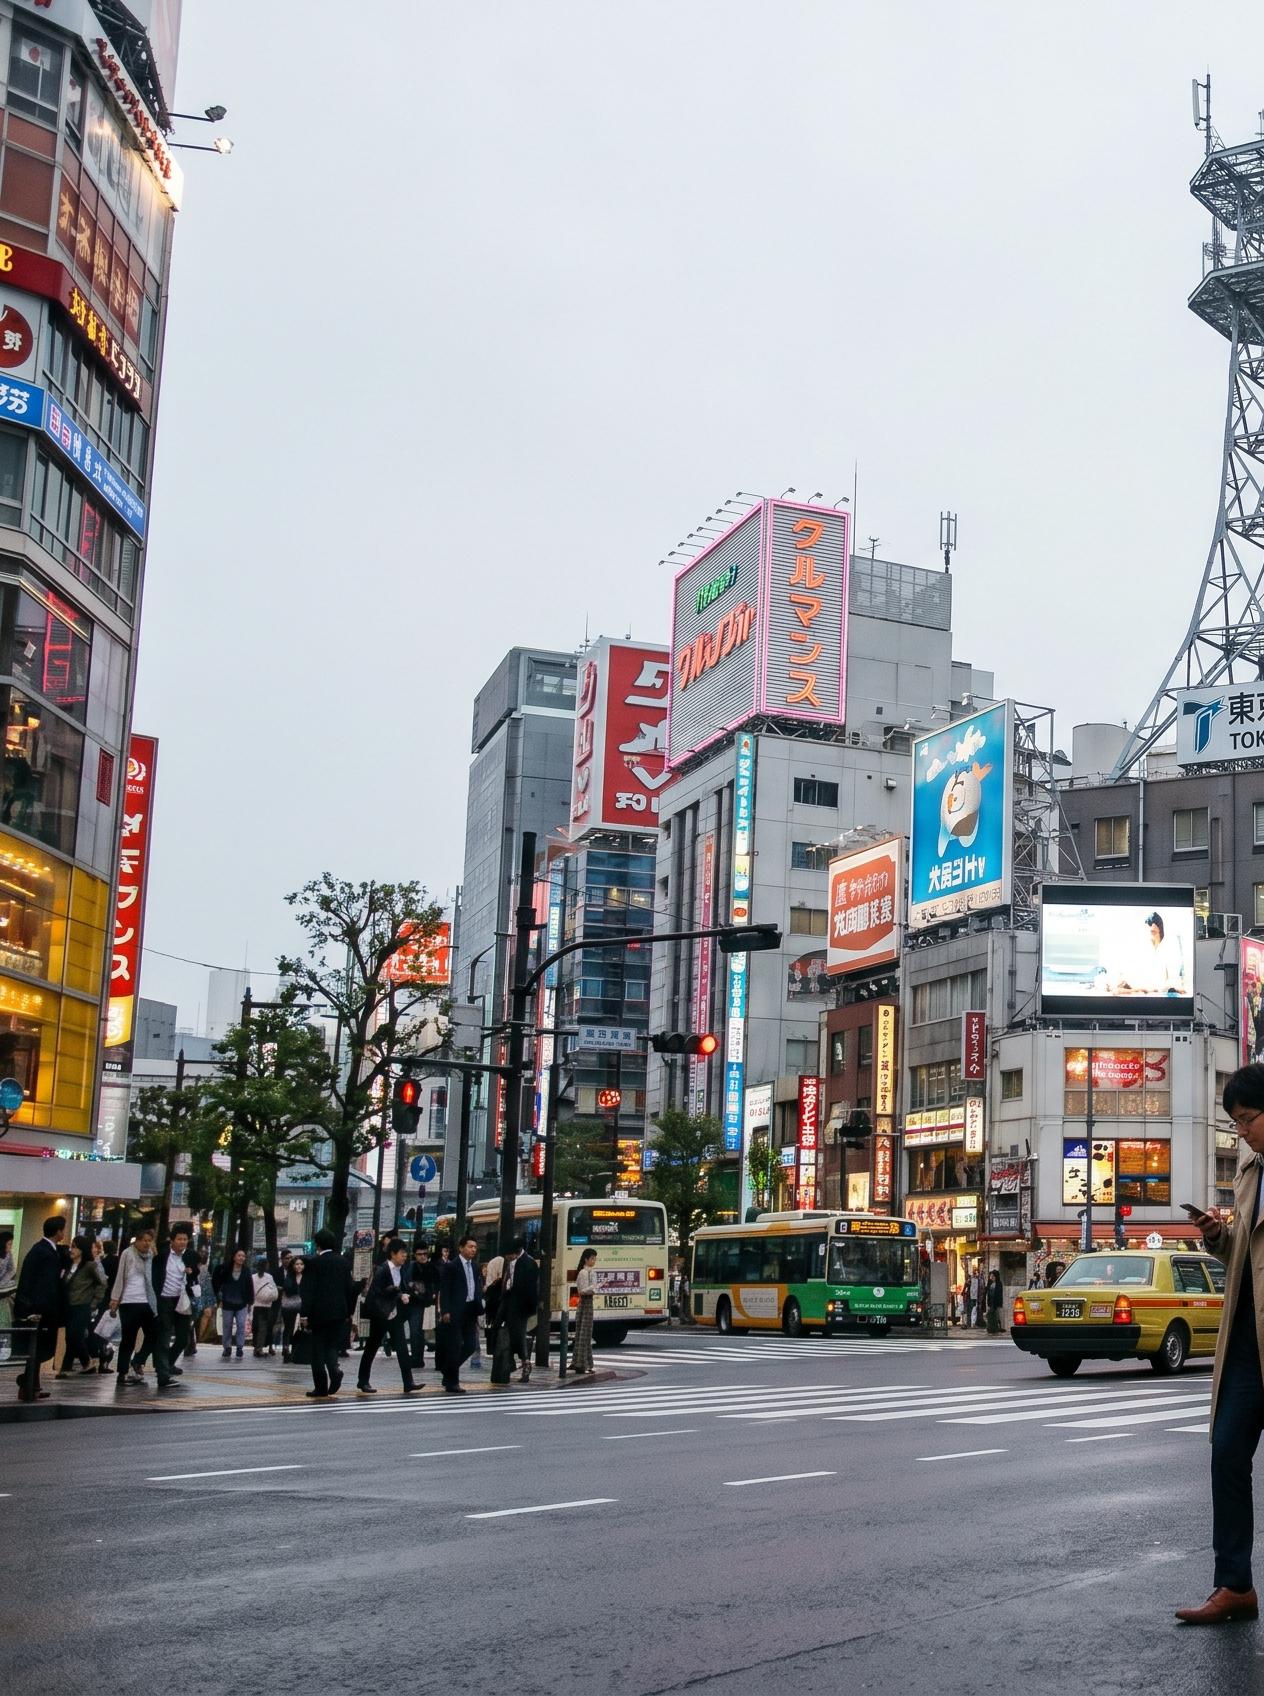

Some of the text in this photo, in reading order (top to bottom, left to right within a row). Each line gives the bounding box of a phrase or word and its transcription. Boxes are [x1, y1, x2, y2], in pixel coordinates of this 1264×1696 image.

[787, 519, 826, 707] クルマンス
